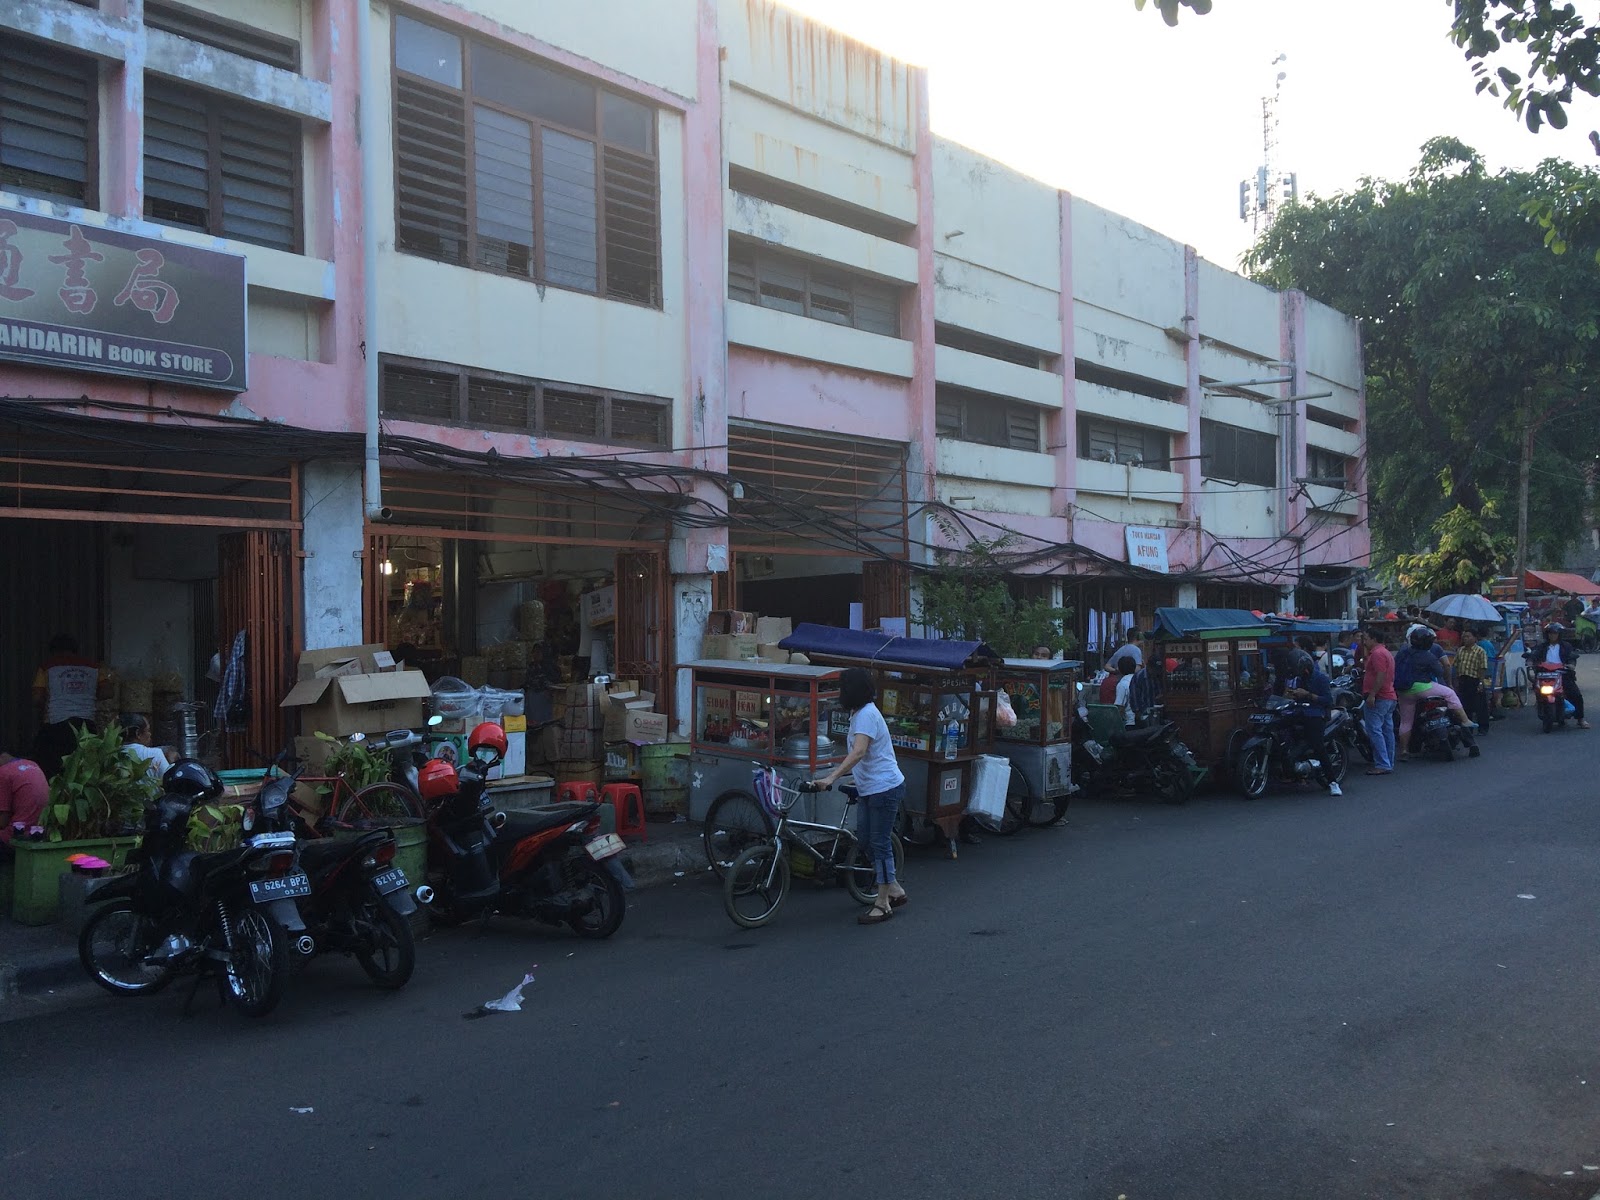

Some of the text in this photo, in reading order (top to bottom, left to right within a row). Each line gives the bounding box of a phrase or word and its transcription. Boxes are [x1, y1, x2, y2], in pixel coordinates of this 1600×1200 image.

[0, 324, 213, 374] ANDARIN BOOK STORE
[1137, 545, 1159, 558] AFUNG
[706, 696, 730, 710] SIOMA
[937, 702, 971, 721] BUBUR
[251, 875, 308, 893] B 6264 BPZ
[375, 872, 397, 886] 6219
